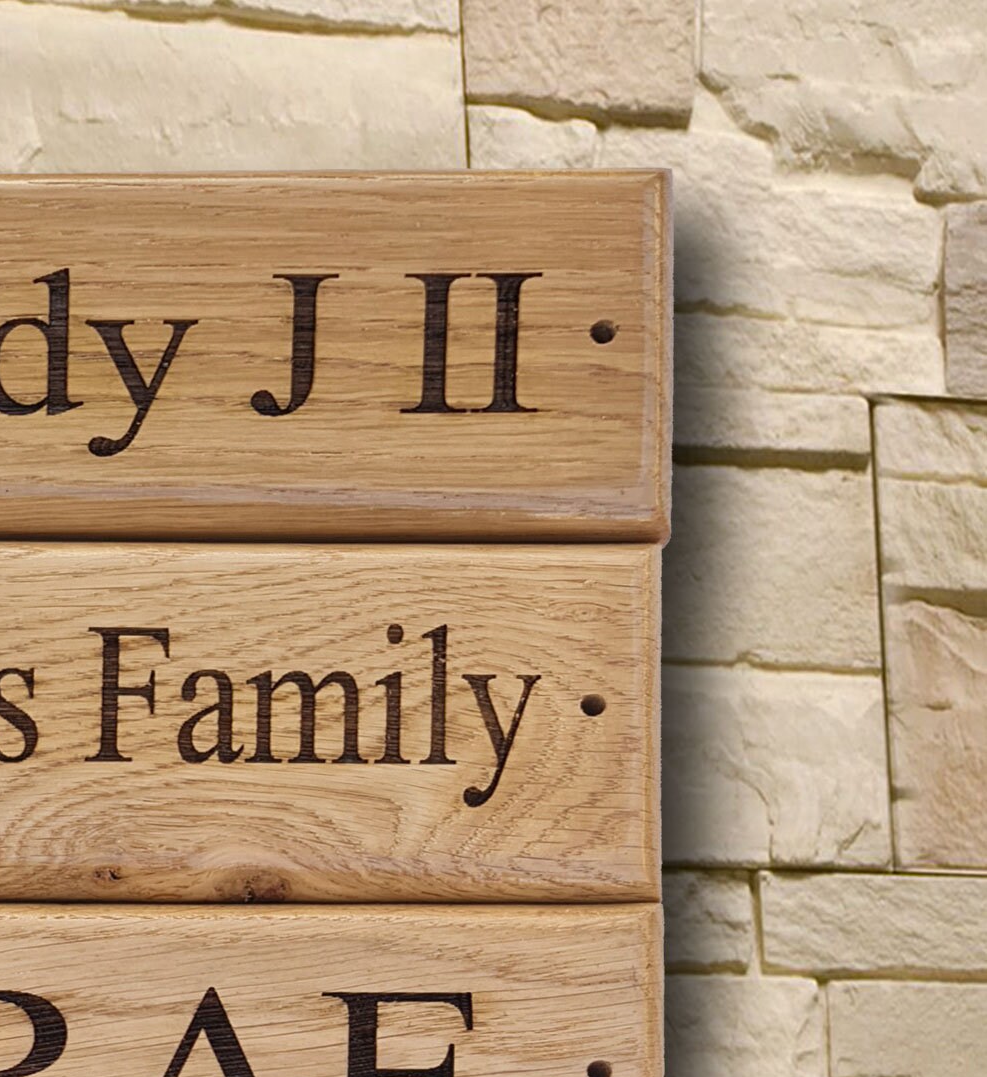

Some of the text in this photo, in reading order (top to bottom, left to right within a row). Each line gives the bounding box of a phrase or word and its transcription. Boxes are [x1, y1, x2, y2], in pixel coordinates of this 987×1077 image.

[251, 274, 339, 416] J
[402, 274, 542, 413] II
[88, 625, 541, 807] Family
